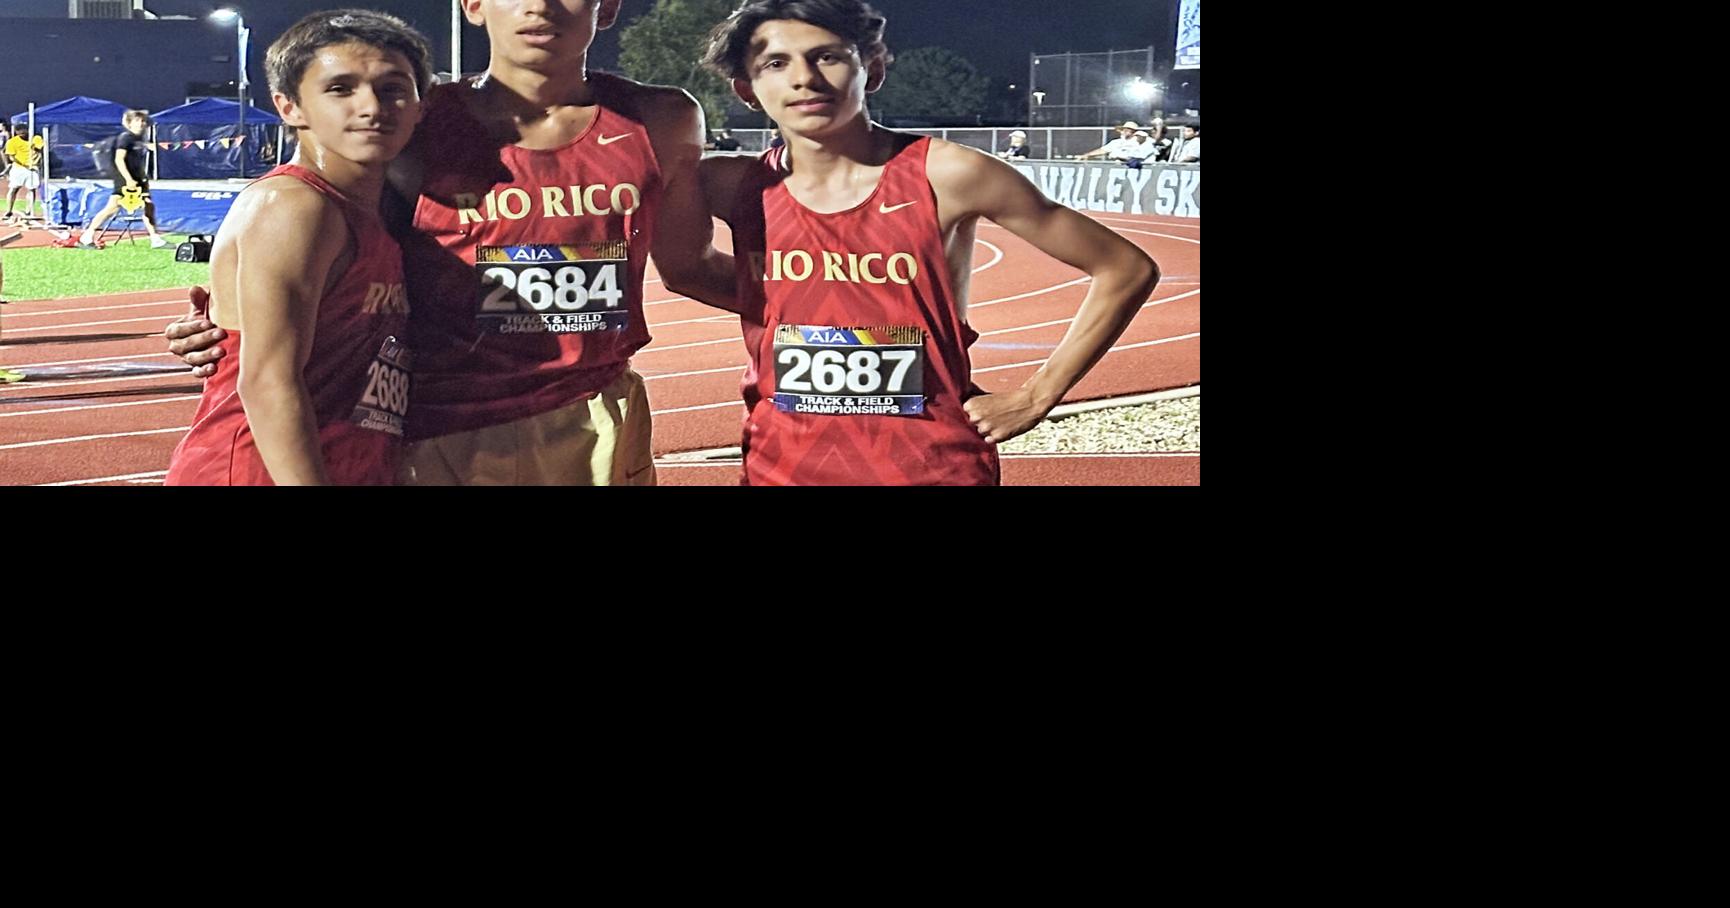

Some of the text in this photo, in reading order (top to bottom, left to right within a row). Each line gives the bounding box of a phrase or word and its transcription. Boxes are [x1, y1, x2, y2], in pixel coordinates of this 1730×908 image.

[1040, 166, 1151, 215] VALLEY
[456, 183, 641, 225] RIO RICO
[513, 248, 553, 260] AIA
[822, 250, 918, 285] RICO
[480, 264, 623, 311] 2684
[500, 322, 608, 334] CHAMPIONSHIPS
[505, 314, 602, 325] TRACK & FIELD
[808, 331, 848, 343] AIA
[778, 349, 917, 393] 2687
[362, 360, 409, 417] 2688
[795, 404, 900, 414] CHAMPIONSHIPS
[799, 397, 894, 406] TRACK & FIELD
